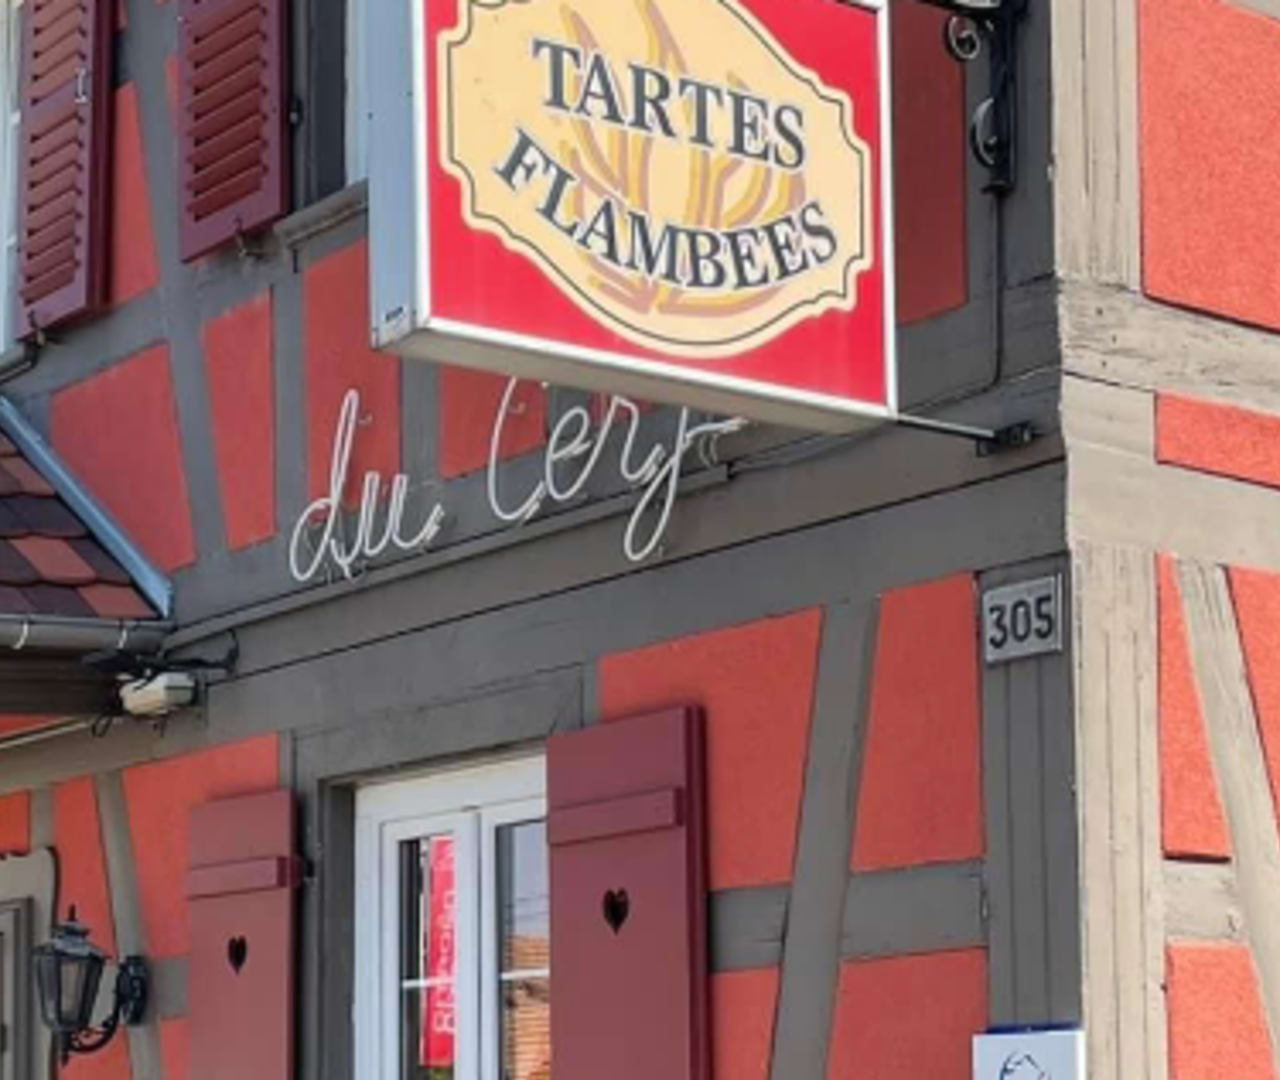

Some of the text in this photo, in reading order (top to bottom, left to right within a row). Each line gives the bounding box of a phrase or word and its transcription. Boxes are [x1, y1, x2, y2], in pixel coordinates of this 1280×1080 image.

[532, 38, 805, 169] TARTES
[492, 126, 838, 291] FLAMBEES
[289, 389, 446, 582] du
[988, 593, 1053, 650] 305
